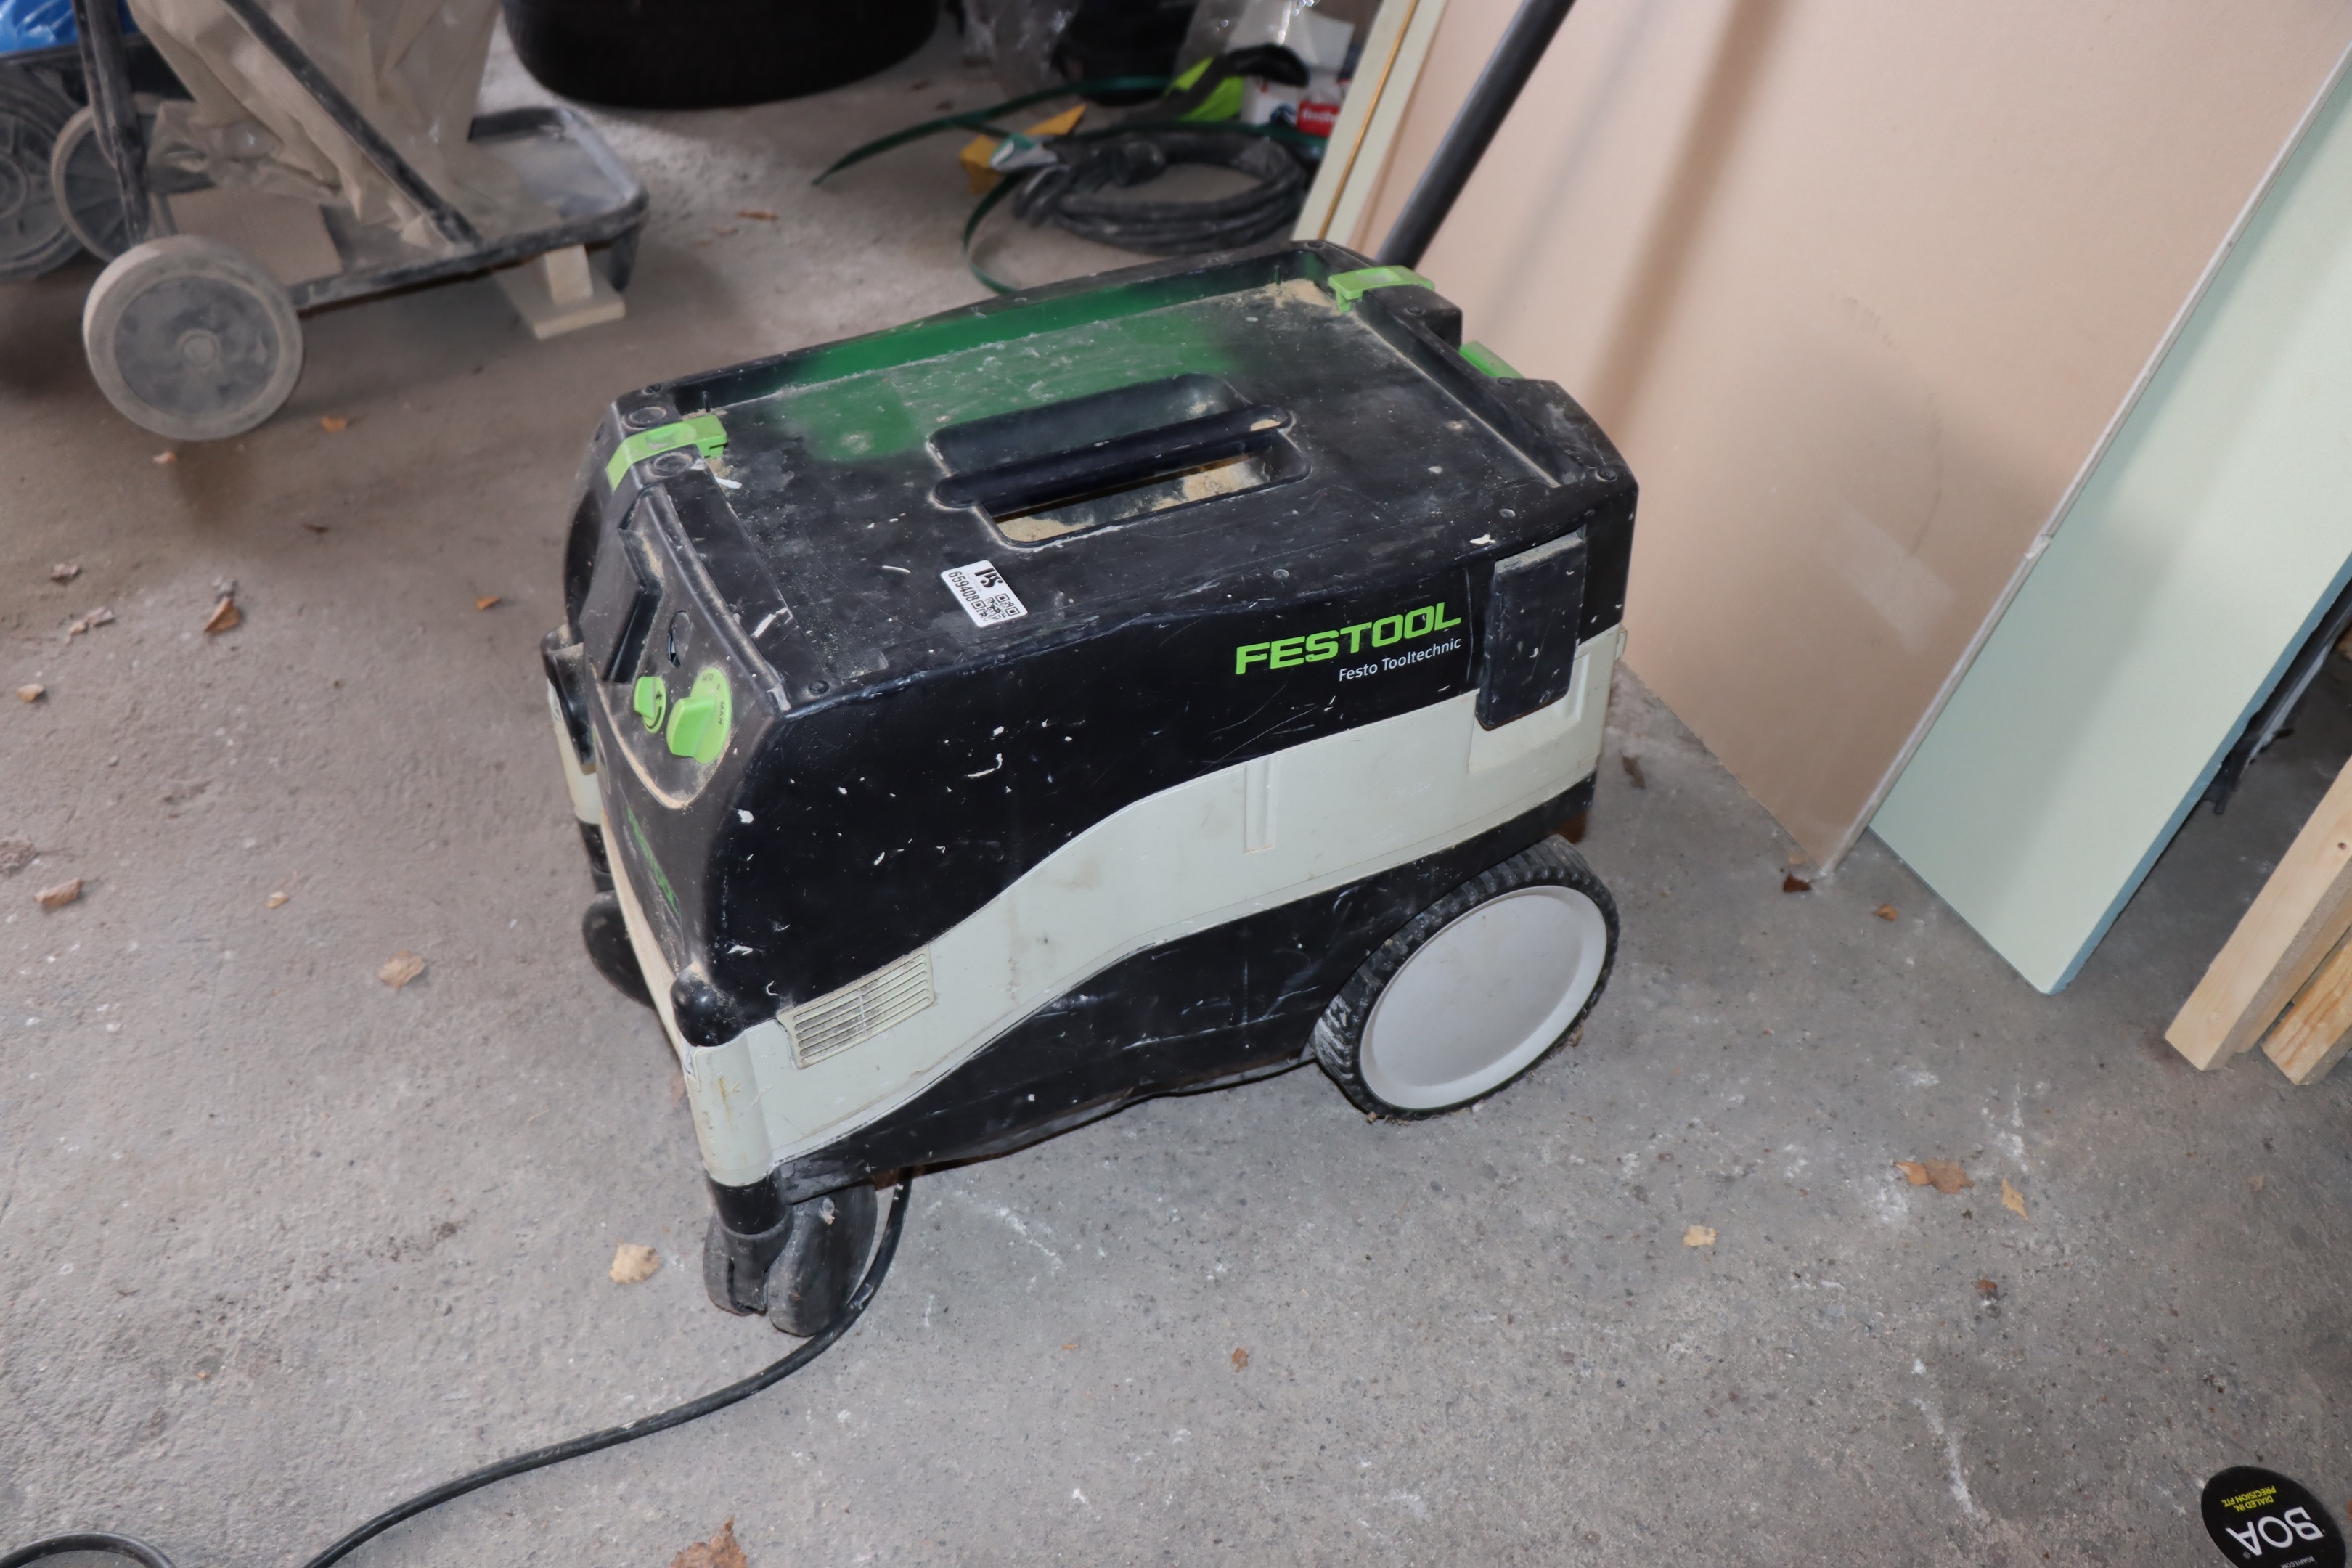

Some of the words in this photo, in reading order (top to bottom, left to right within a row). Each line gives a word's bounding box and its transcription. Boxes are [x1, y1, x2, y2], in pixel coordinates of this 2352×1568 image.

[948, 571, 980, 602] 659408
[1236, 602, 1461, 674] FESTOOL
[1339, 663, 1378, 682] Festo
[1381, 637, 1461, 671] Tooltechnic
[2221, 1497, 2236, 1507] FIT.
[2236, 1485, 2277, 1503] PRECISION
[2246, 1495, 2274, 1510] DIALED
